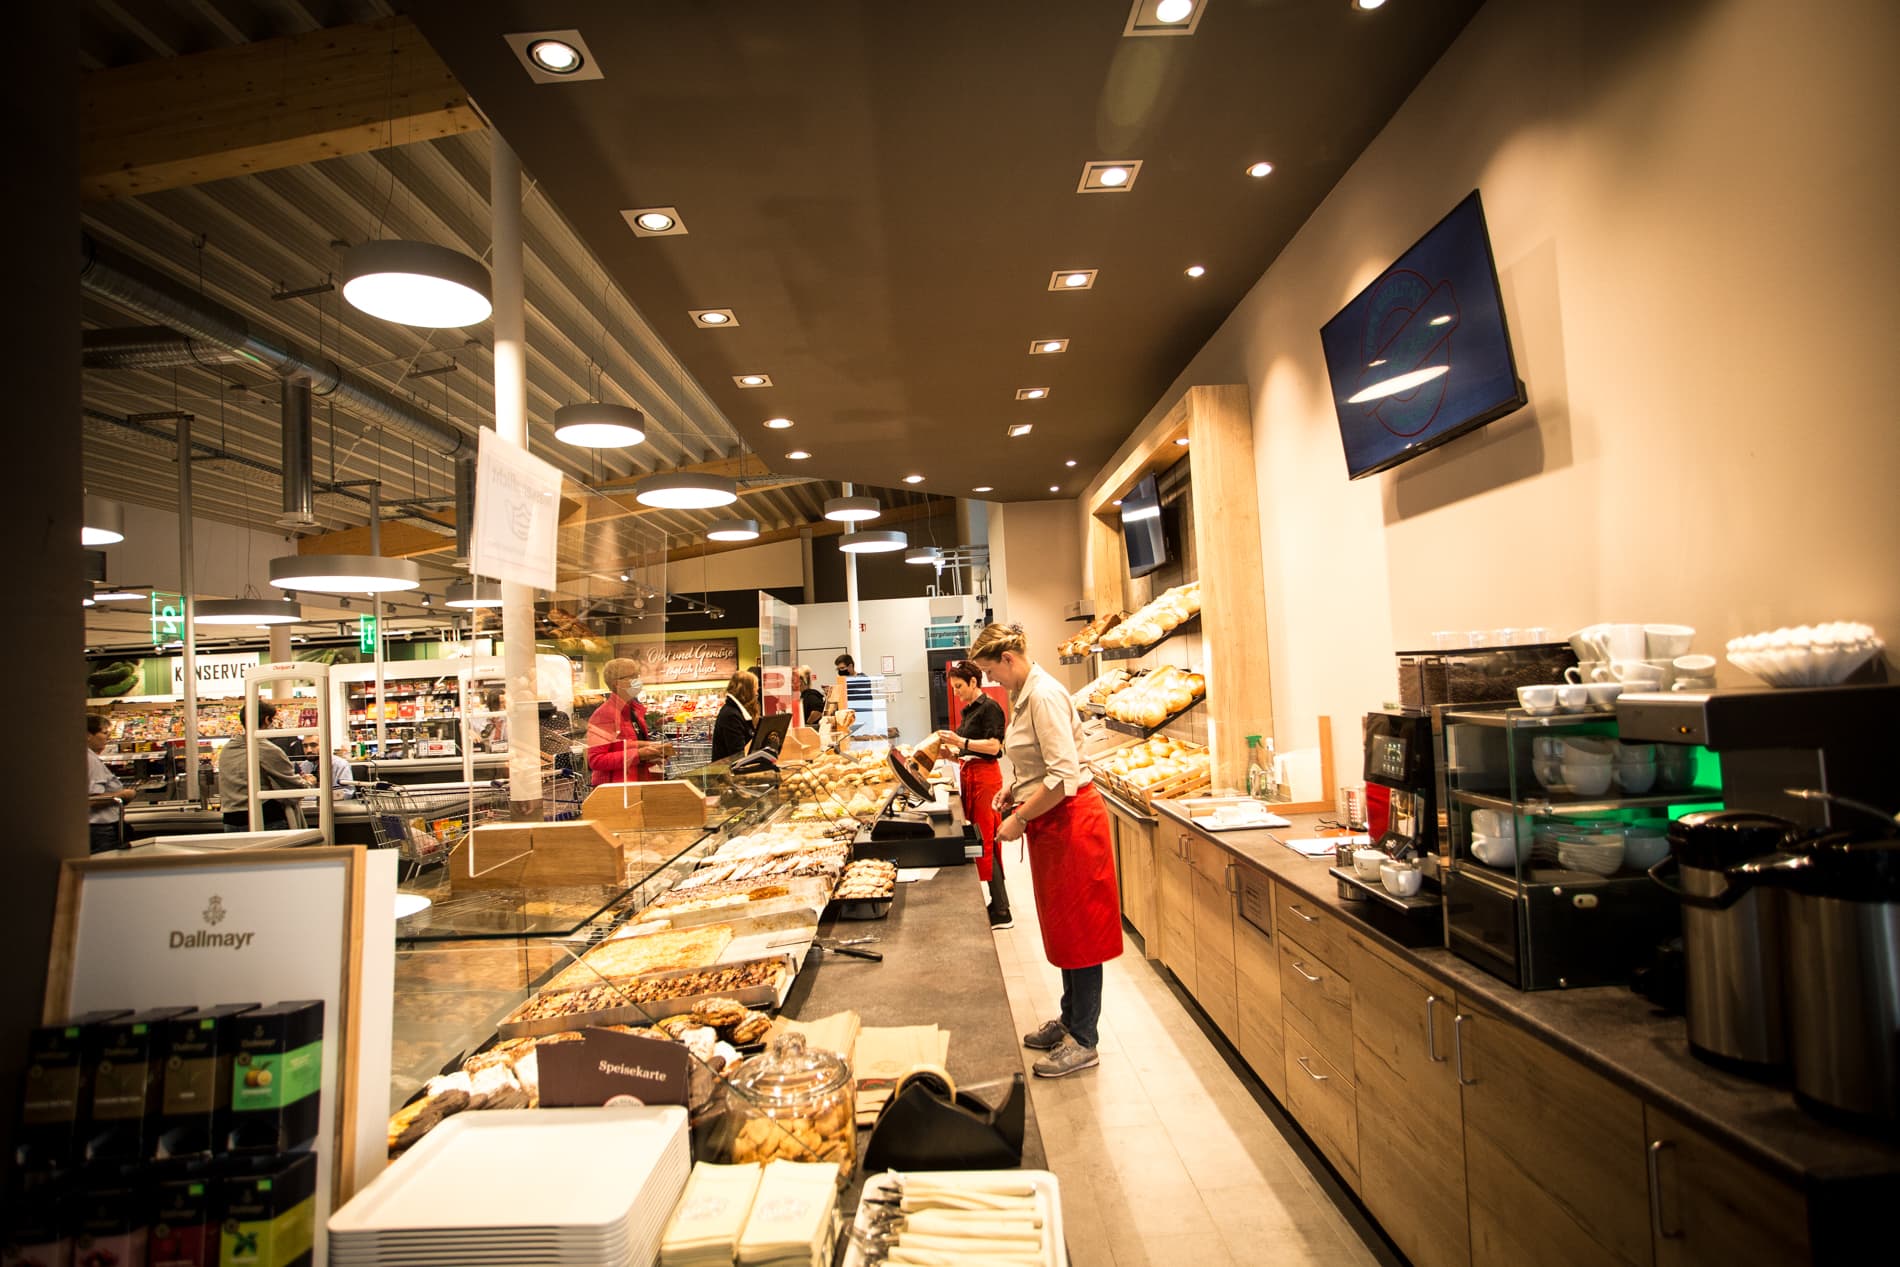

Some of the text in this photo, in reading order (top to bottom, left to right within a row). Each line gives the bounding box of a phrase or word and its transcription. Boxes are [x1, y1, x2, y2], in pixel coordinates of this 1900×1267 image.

[646, 643, 733, 665] Obst und Gemüse
[175, 663, 262, 684] KNSERVE
[693, 662, 716, 678] frisch
[169, 929, 256, 951] Dallmayr
[598, 1059, 667, 1082] Speisekarte
